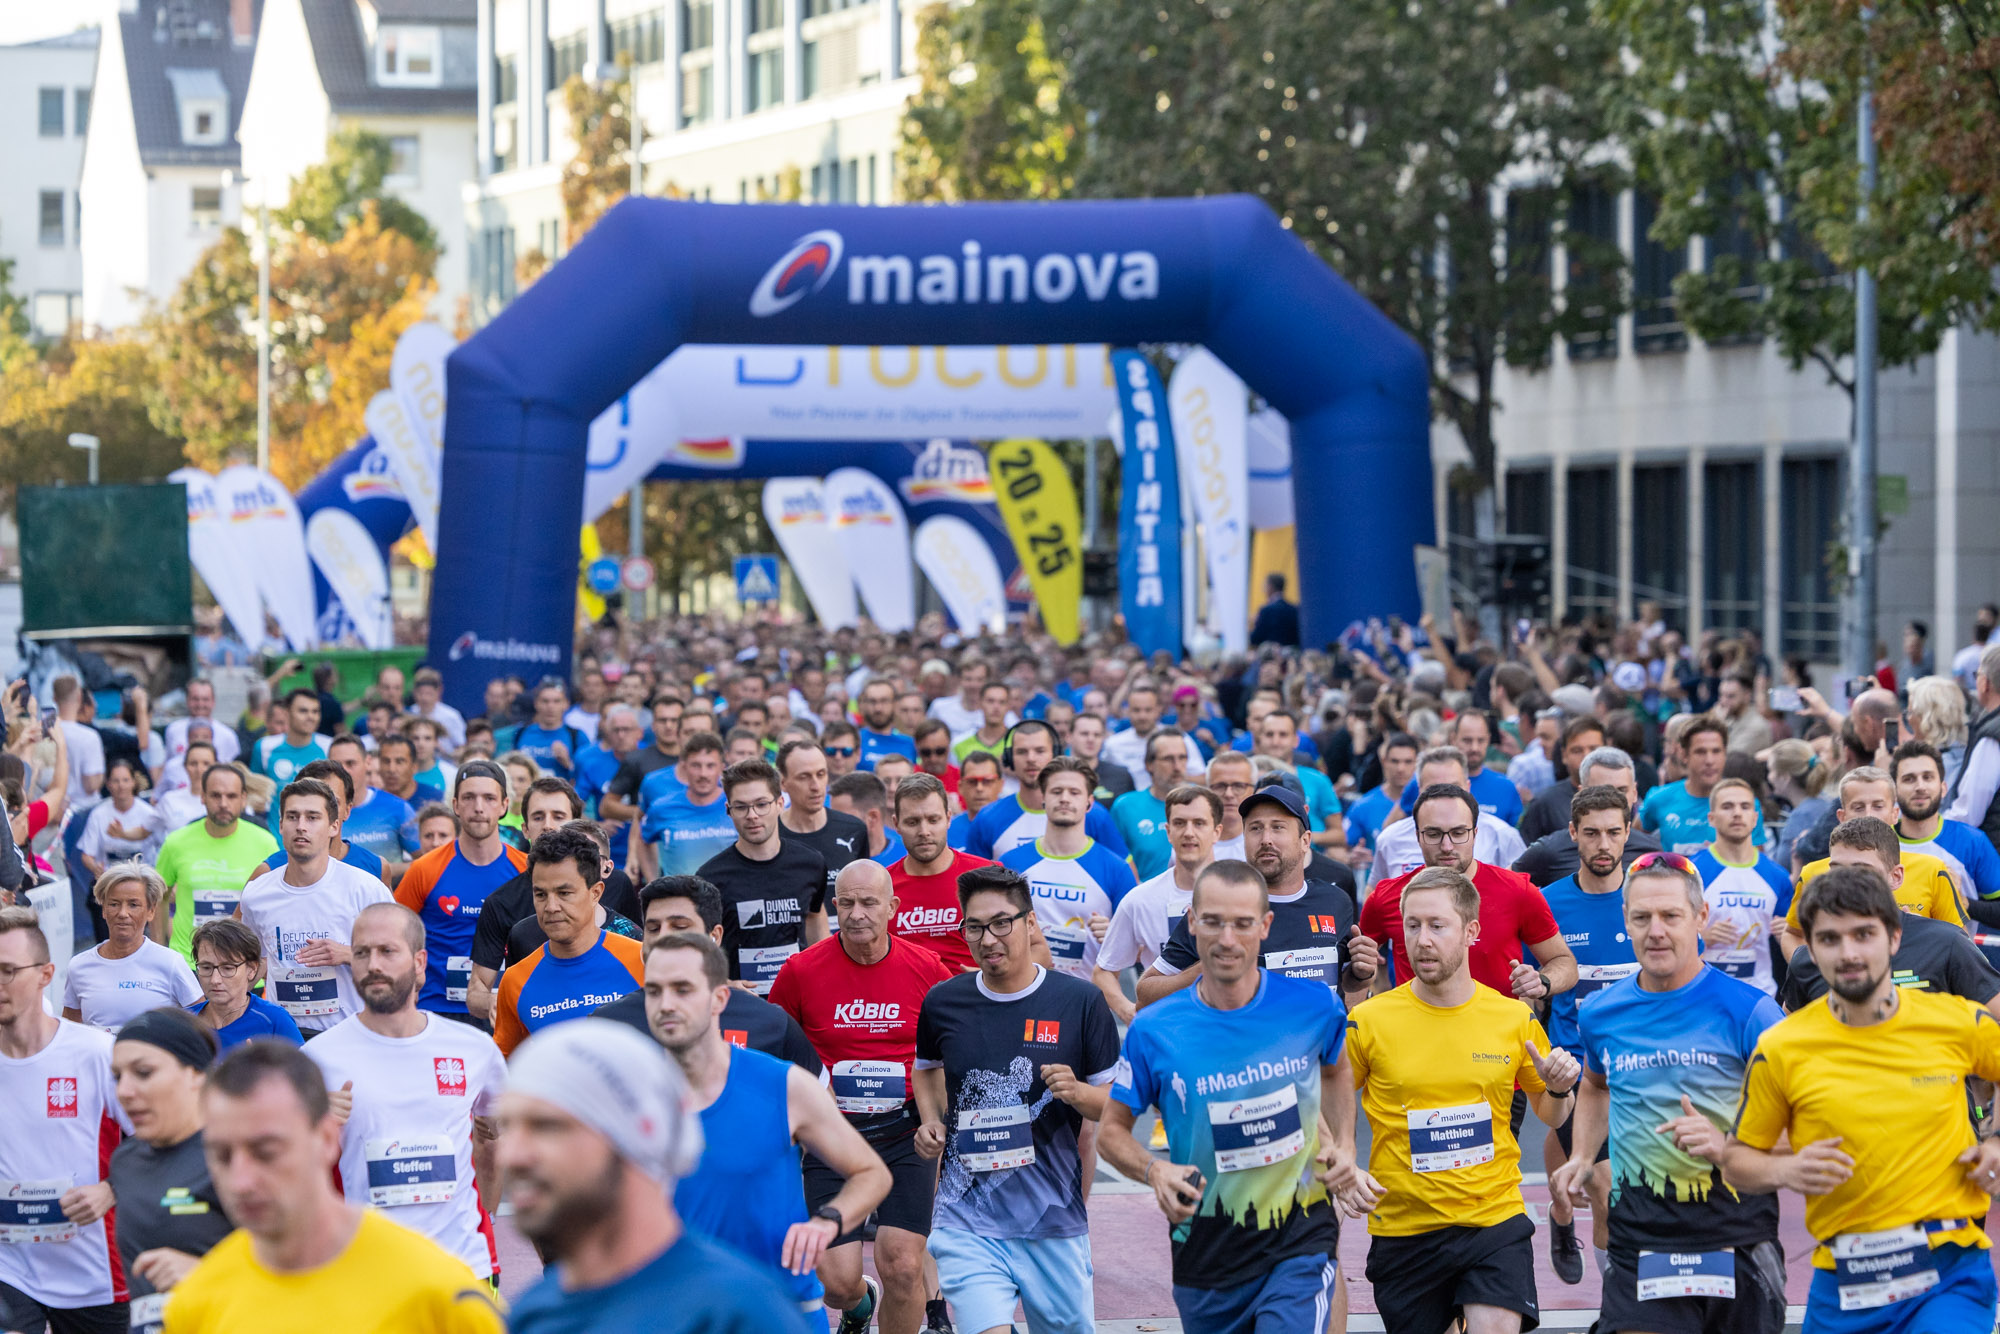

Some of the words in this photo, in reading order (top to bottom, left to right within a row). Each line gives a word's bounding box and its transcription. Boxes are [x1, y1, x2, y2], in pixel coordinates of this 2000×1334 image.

[848, 239, 1160, 303] mainova
[922, 450, 984, 478] dm
[999, 448, 1043, 499] 20
[1029, 523, 1075, 577] 25
[473, 638, 561, 663] mainova
[766, 898, 801, 913] DUNKEL
[767, 911, 790, 925] BLAU
[896, 906, 958, 930] KÖBIG
[1322, 920, 1336, 934] abs
[283, 931, 329, 943] DEUTSCHE
[764, 951, 790, 959] mainova
[1295, 954, 1325, 962] mainova
[295, 971, 322, 979] mainova
[1285, 968, 1324, 979] Christian
[1602, 969, 1631, 977] mainova
[294, 984, 314, 993] Felix
[530, 991, 624, 1019] Sparda-Bank
[834, 999, 900, 1023] KÖBIG
[1037, 1025, 1058, 1044] abs
[1616, 1048, 1718, 1072] #MachDeins
[1195, 1055, 1309, 1096] #MachDeins
[856, 1078, 883, 1088] Volker
[1244, 1101, 1282, 1116] mainova
[981, 1114, 1013, 1124] mainova
[1440, 1112, 1476, 1123] mainova
[1241, 1119, 1277, 1136] Ulrich
[974, 1130, 1011, 1142] Mortaza
[1430, 1128, 1475, 1142] Matthieu
[400, 1144, 438, 1153] mainova
[392, 1160, 433, 1174] Steffen
[21, 1188, 57, 1196] mainova
[17, 1202, 50, 1214] Benno
[1669, 1253, 1703, 1266] Claus
[1846, 1252, 1914, 1275] Christopher
